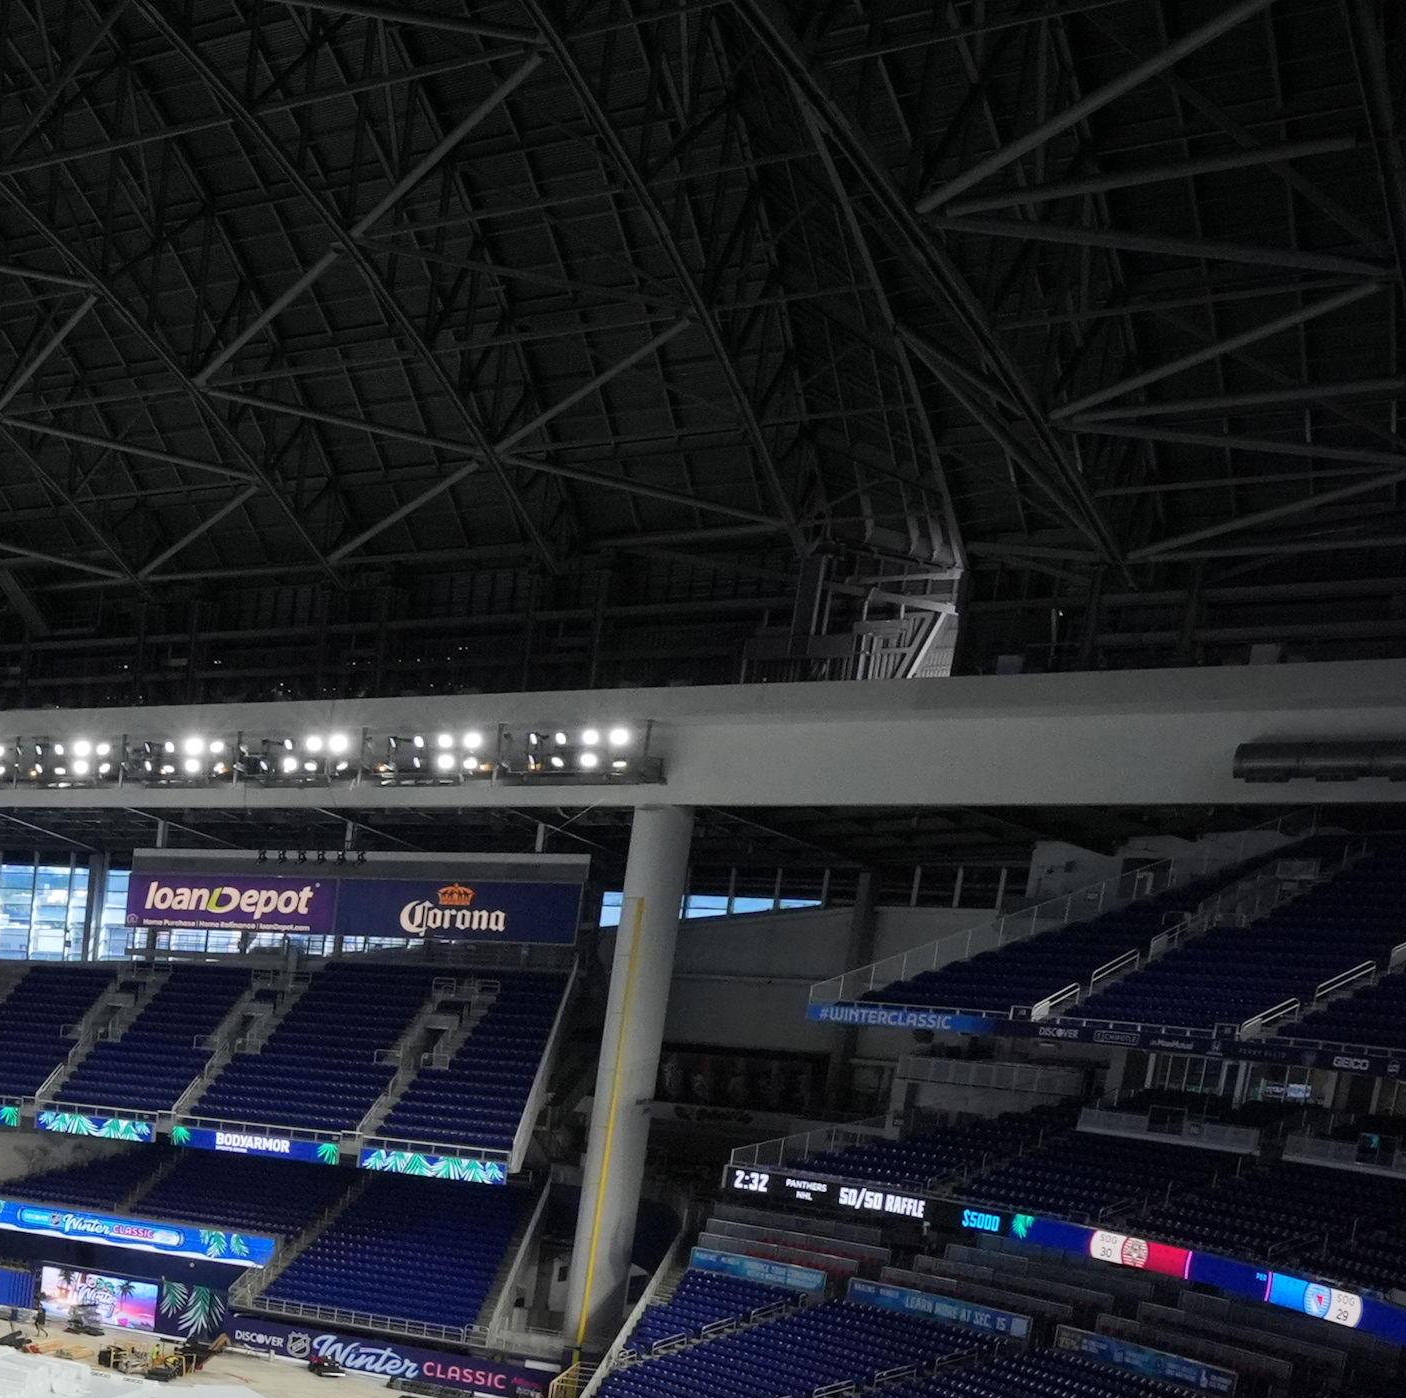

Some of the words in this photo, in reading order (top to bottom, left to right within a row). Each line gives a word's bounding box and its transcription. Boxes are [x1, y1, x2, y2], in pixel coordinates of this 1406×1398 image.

[144, 880, 314, 920] loanDepot
[400, 899, 507, 936] Corona
[818, 1005, 953, 1031] #WINTERCLASSIC
[1039, 1026, 1079, 1040] DISCOVER
[1332, 1055, 1370, 1071] GEICO
[215, 1132, 291, 1154] BODYARMOR
[733, 1170, 770, 1193] 2:32
[785, 1178, 828, 1193] PANTHERS
[795, 1190, 813, 1201] NHL
[838, 1186, 883, 1211] 50/50
[884, 1194, 926, 1219] RAFFLE
[62, 1213, 110, 1235] Winter
[112, 1224, 154, 1240] CLASSIC
[961, 1208, 1001, 1233] $5000
[1100, 1247, 1113, 1259] 30
[1337, 1293, 1356, 1307] SOG
[1335, 1308, 1349, 1322] 29
[234, 1329, 284, 1349] DISCOVER
[312, 1333, 420, 1380] Winter
[422, 1361, 507, 1390] CLASSIC
